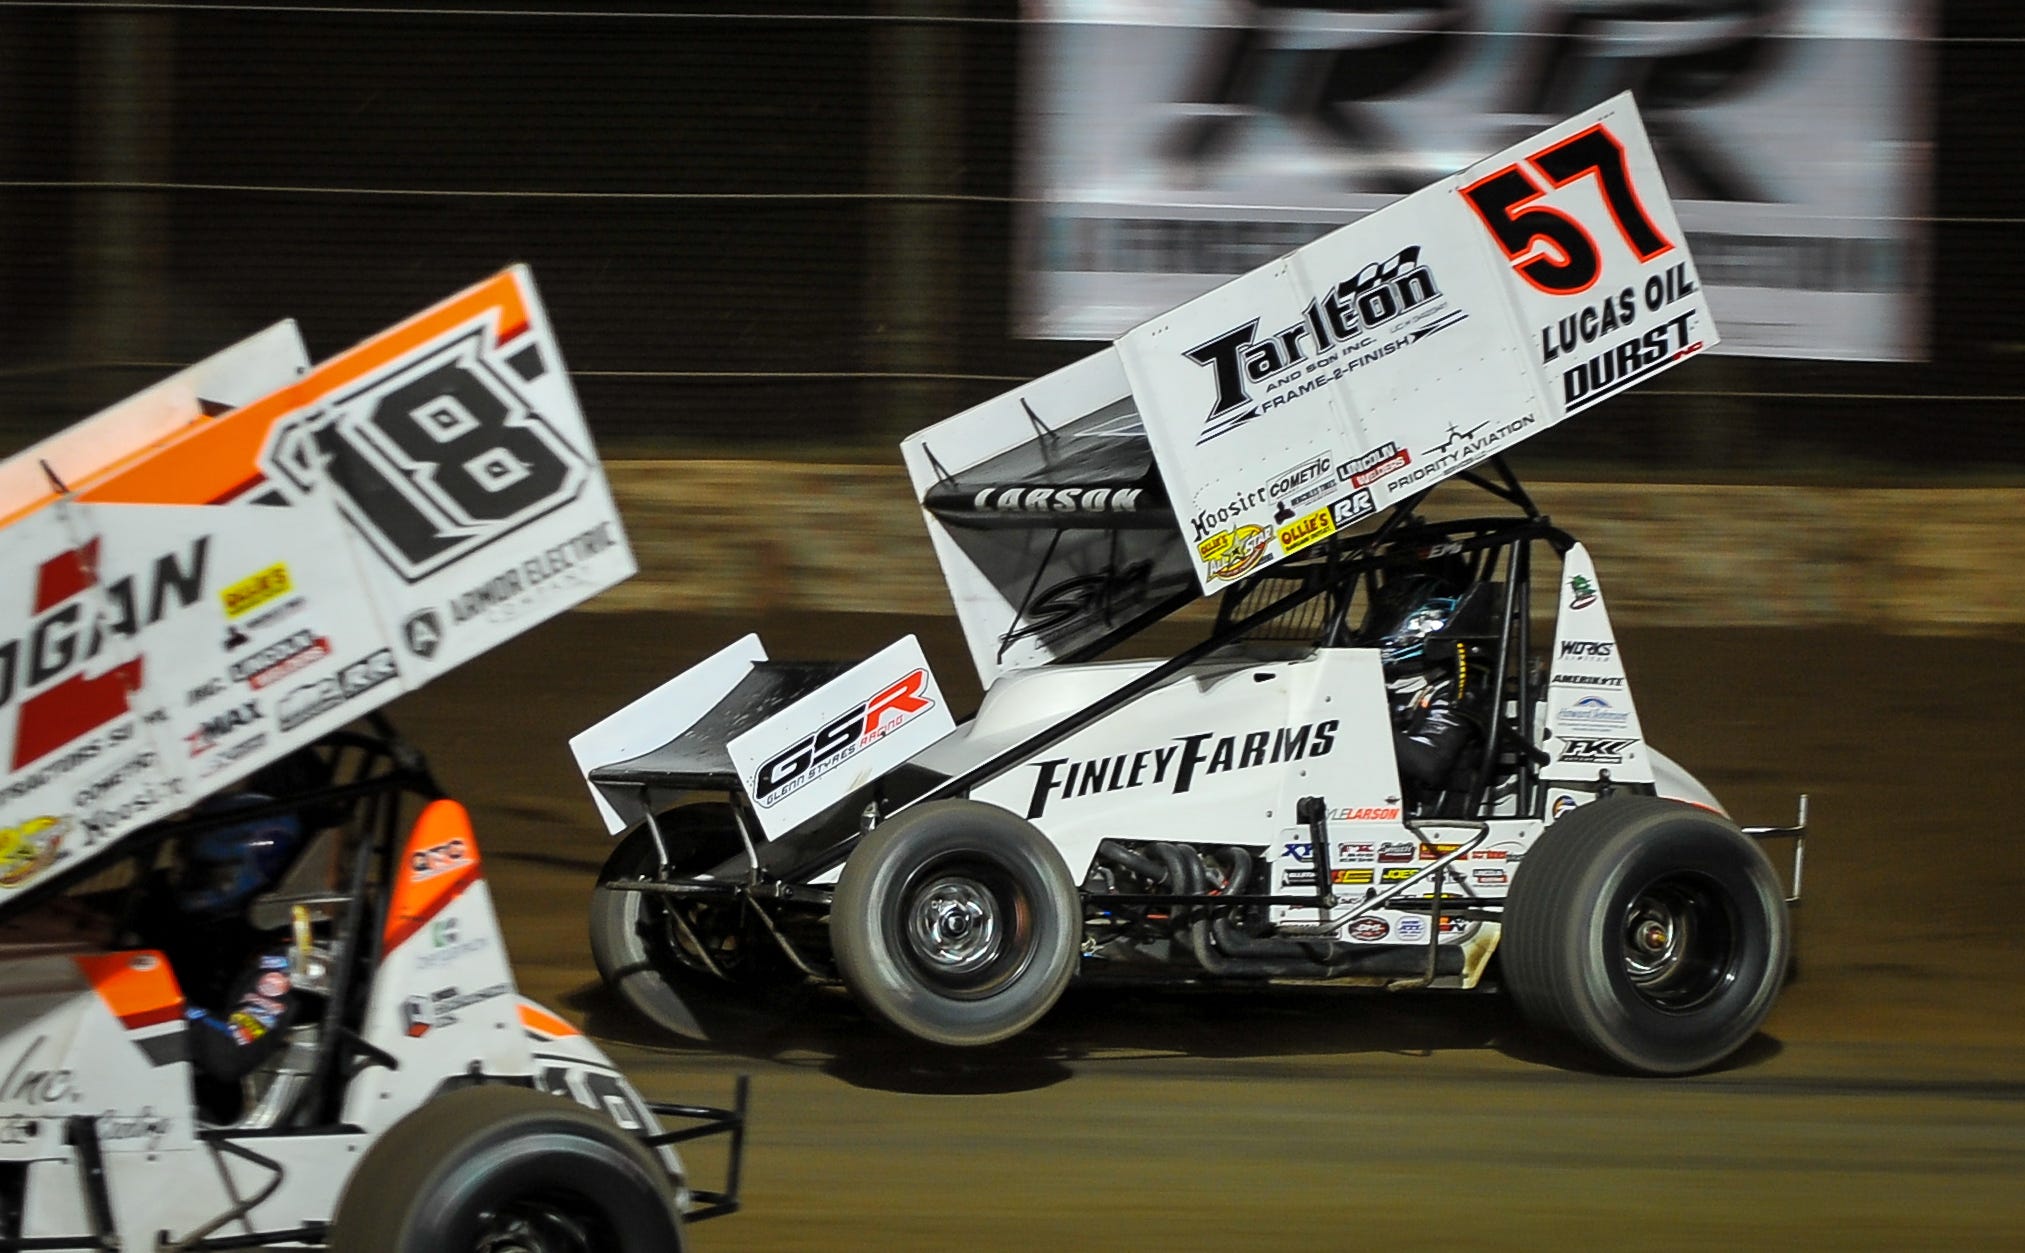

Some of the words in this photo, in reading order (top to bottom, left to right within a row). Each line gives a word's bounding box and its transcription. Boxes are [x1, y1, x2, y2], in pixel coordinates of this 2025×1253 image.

[1458, 122, 1676, 296] 57
[1181, 265, 1443, 424] Tarlton
[1541, 287, 1636, 364] LUCAS
[1645, 262, 1699, 312] OIL
[1265, 370, 1302, 394] AND
[1306, 353, 1340, 375] SON
[1563, 308, 1697, 405] DURST
[1269, 456, 1331, 498] COMETIC
[1387, 450, 1459, 493] PRIORITY
[1463, 412, 1536, 457] AVIATION
[974, 487, 1143, 513] LARSON
[1190, 487, 1266, 542] Hoosier
[1281, 509, 1330, 546] OLLIE'S
[0, 535, 212, 714] GAN
[1560, 640, 1615, 660] WORKS
[757, 669, 930, 801] GSR
[1027, 745, 1179, 820] FINLEY
[1172, 719, 1341, 795] FARMS
[766, 776, 805, 806] GLENN
[809, 745, 856, 779] STYRES
[1346, 808, 1400, 820] LARSON
